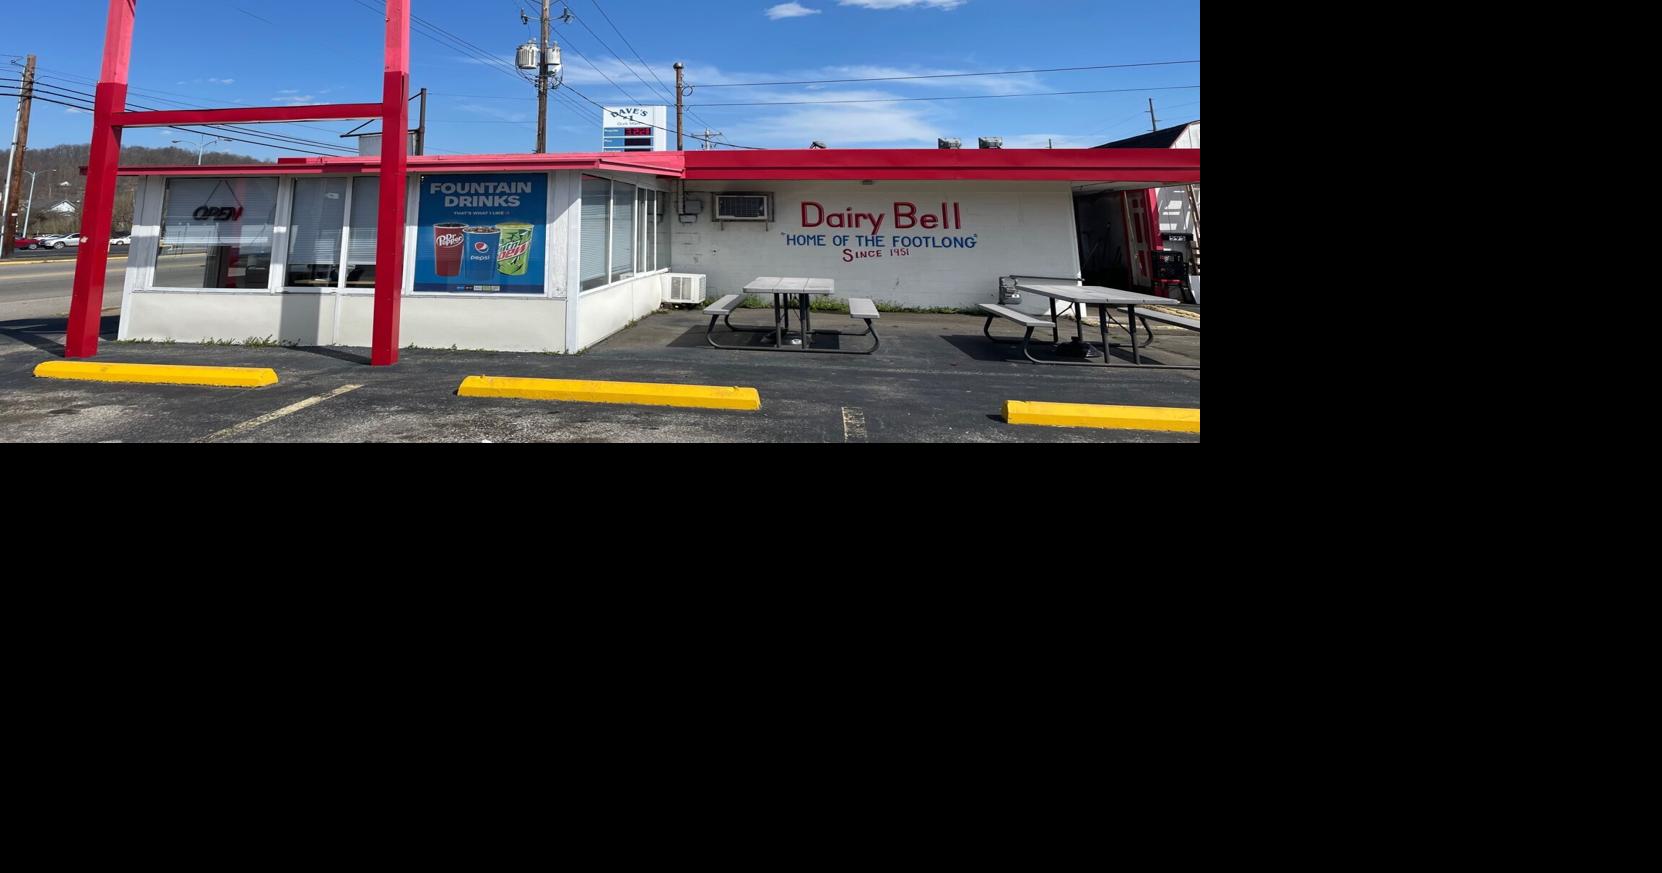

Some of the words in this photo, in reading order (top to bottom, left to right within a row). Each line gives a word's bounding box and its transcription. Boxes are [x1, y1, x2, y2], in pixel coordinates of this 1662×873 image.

[430, 182, 532, 194] FOUNTAIN
[444, 195, 521, 207] DRINKS
[193, 206, 243, 220] OPEN
[801, 201, 885, 235] Dairy
[893, 201, 962, 230] Bell
[437, 235, 463, 246] Pepper
[832, 235, 850, 246] OF
[855, 235, 885, 247] THE
[890, 248, 909, 256] 1951
